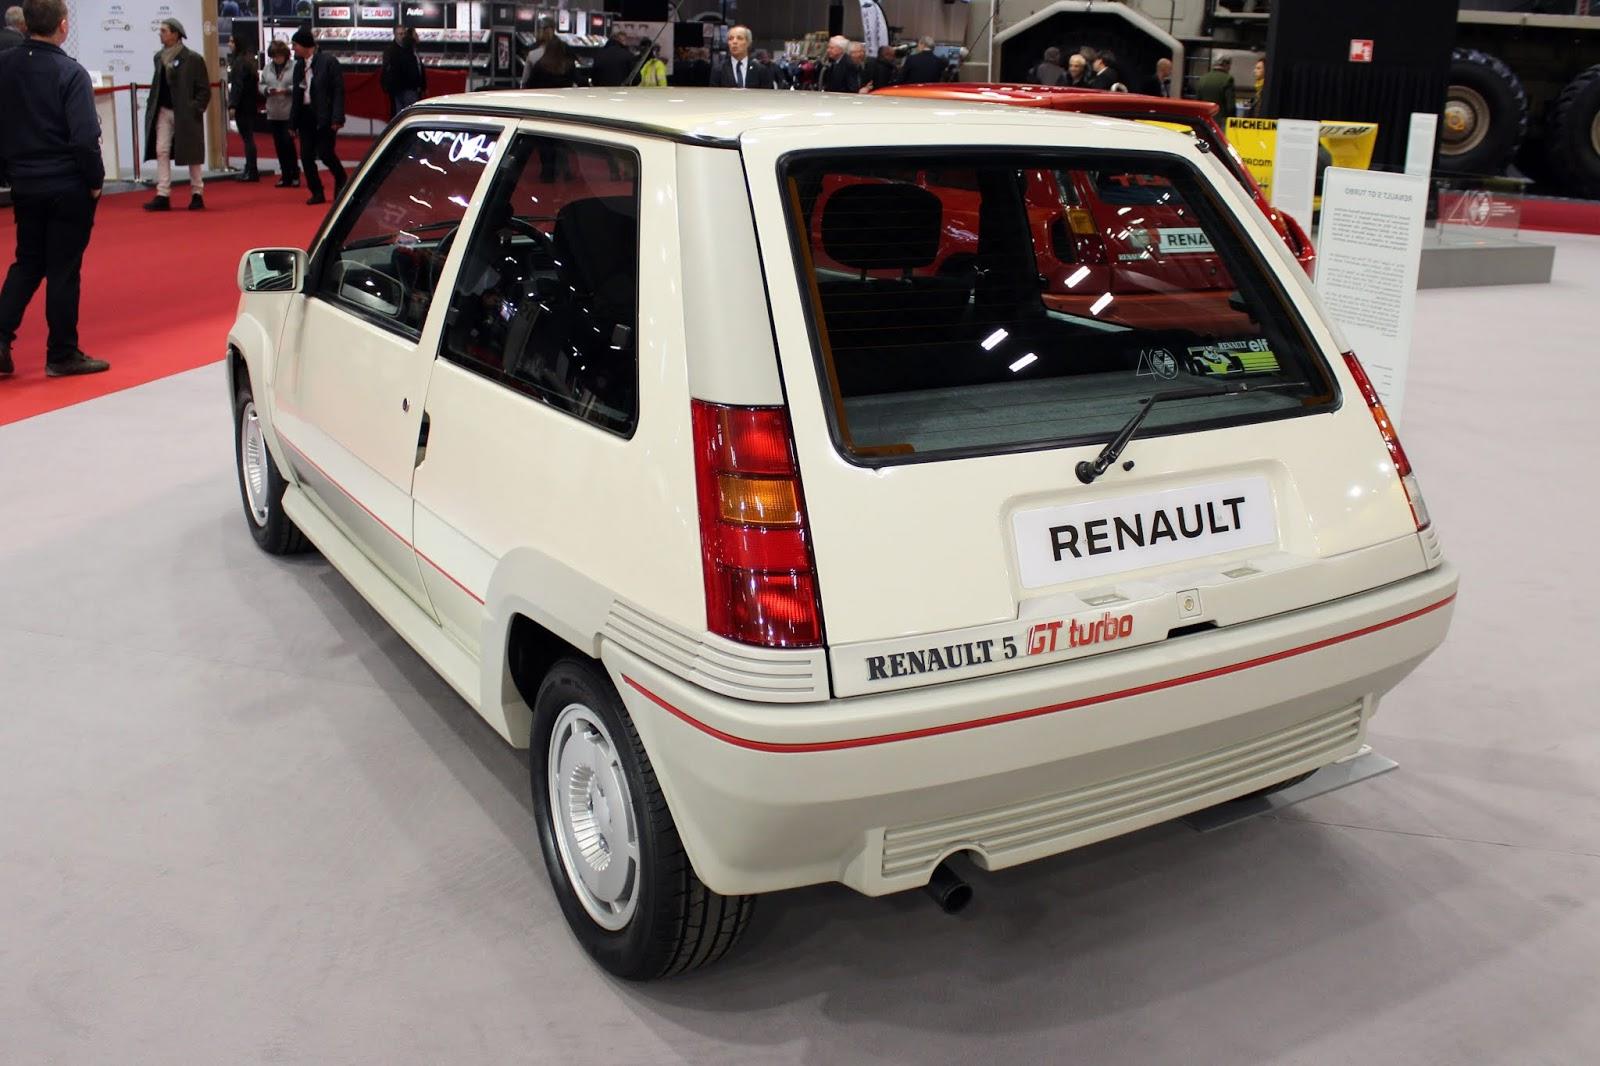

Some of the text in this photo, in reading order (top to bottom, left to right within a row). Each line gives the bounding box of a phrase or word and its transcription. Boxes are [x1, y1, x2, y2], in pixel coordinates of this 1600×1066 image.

[1229, 119, 1278, 130] MICHELIN
[1167, 234, 1208, 246] RENA
[1248, 338, 1271, 352] elf
[1049, 496, 1245, 561] RENAULT
[867, 611, 1133, 681] RENAULT 5 GT turbo
